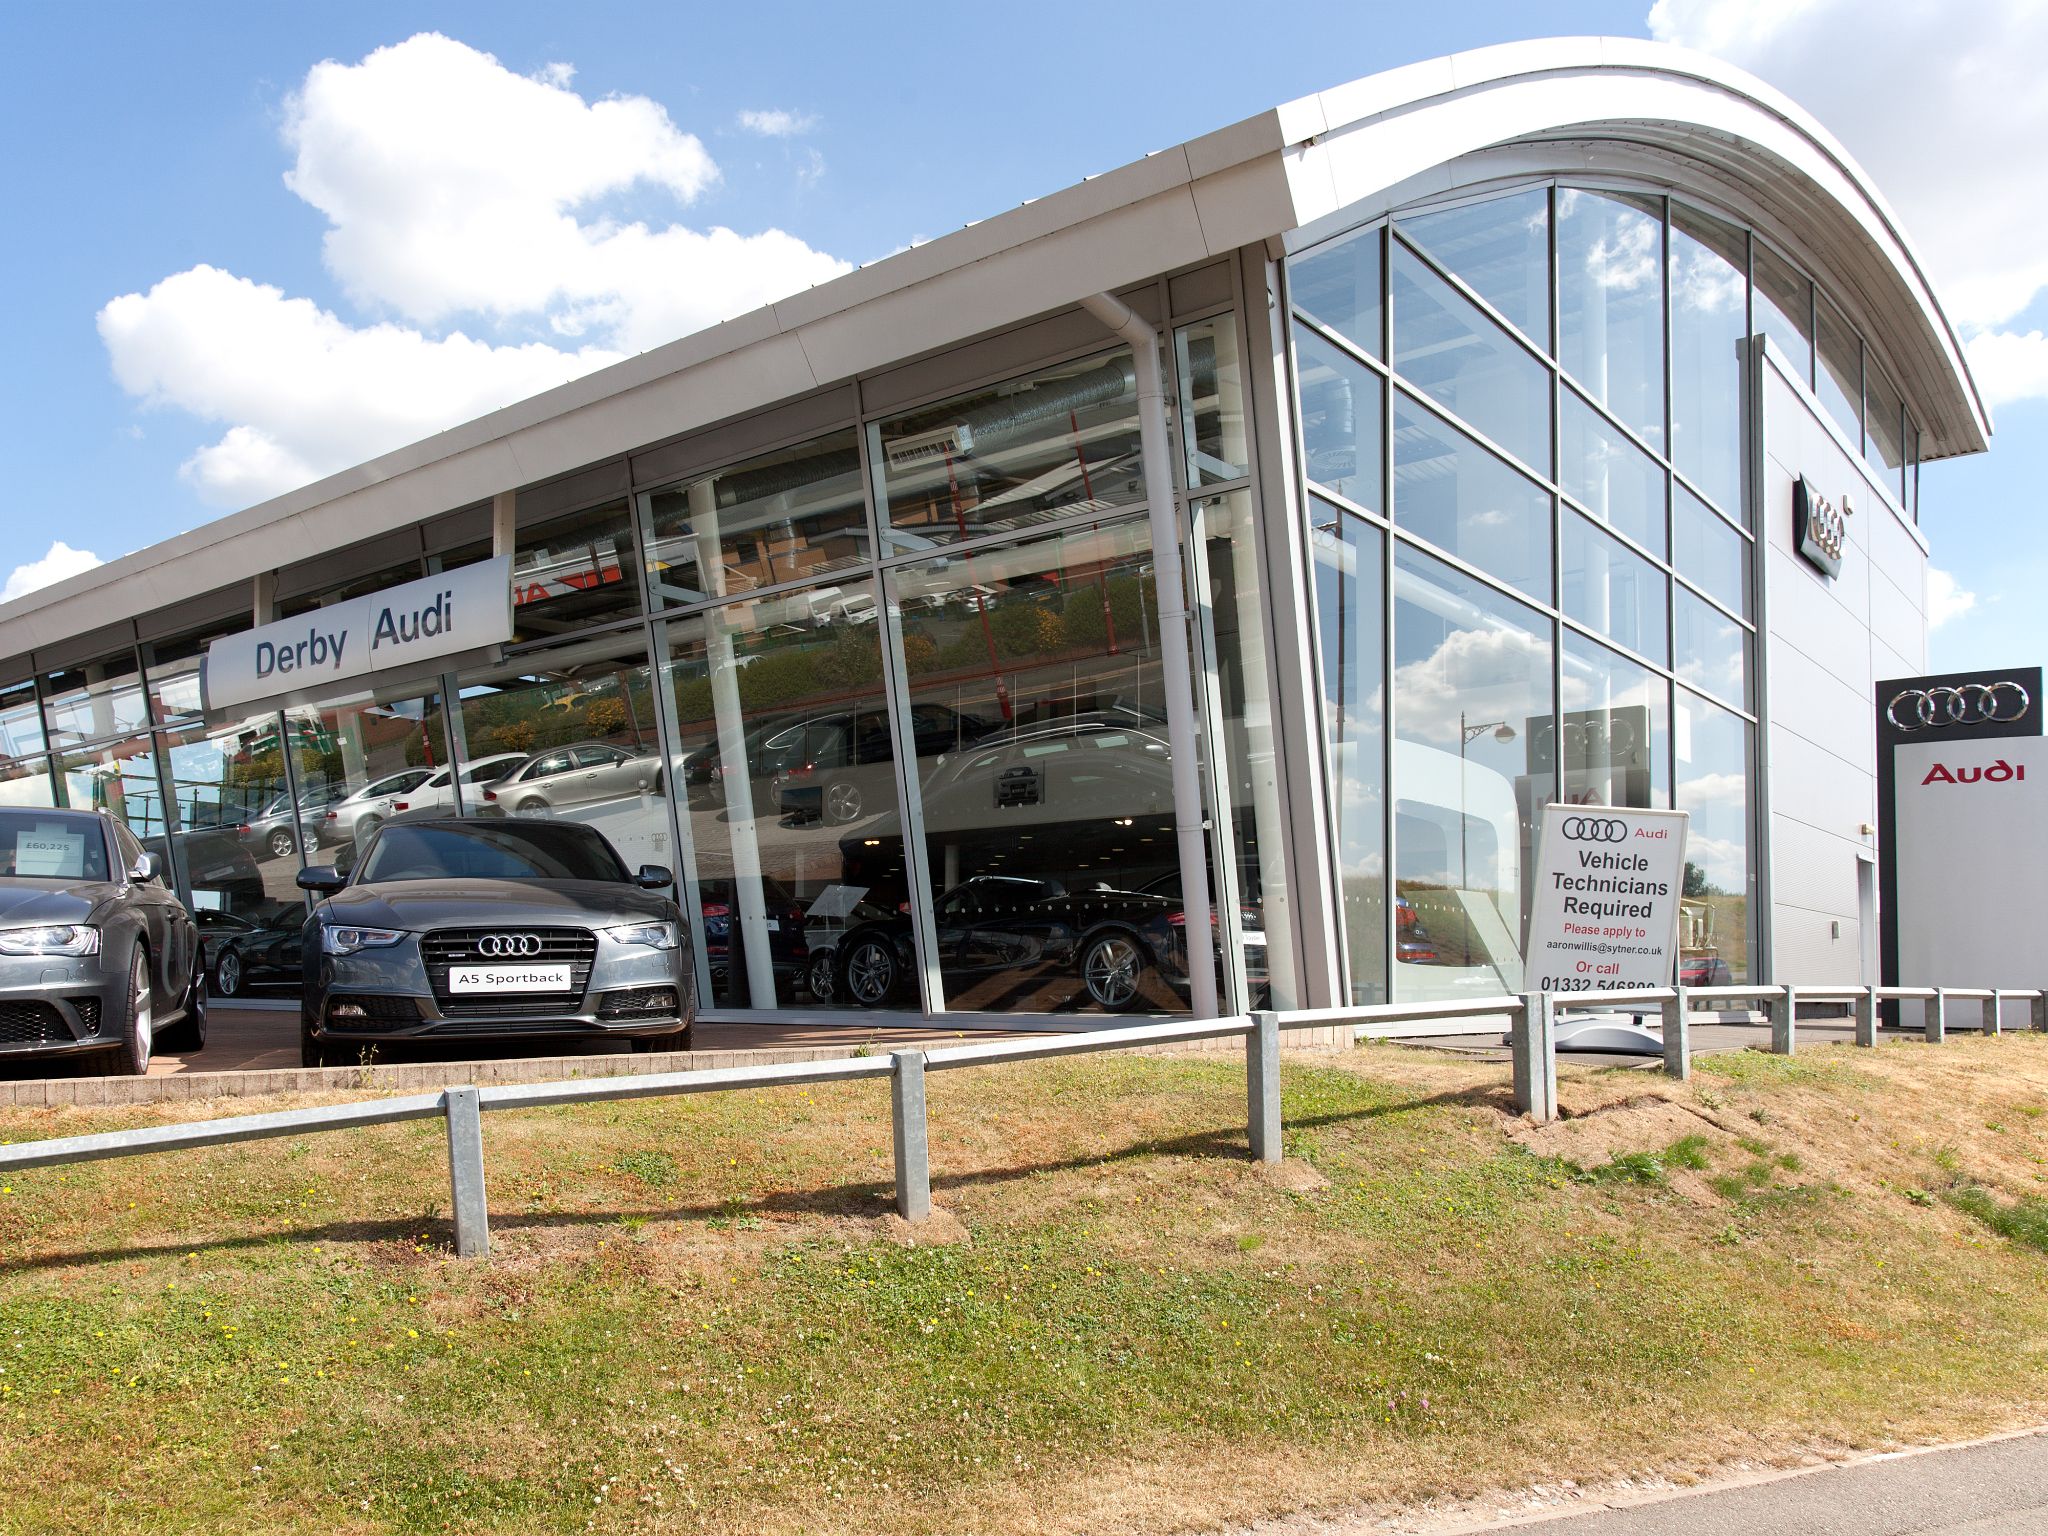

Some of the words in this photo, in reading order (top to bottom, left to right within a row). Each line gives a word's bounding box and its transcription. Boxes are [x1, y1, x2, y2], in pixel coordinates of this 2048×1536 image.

[256, 628, 348, 679] Derby
[372, 590, 452, 650] Audi
[1920, 759, 2025, 786] Audi
[1634, 828, 1668, 839] Audi
[1579, 850, 1649, 871] Vehicle
[1552, 872, 1668, 896] Technicians
[1563, 896, 1652, 919] Required
[1564, 923, 1600, 935] Please
[1603, 926, 1632, 939] apply
[1635, 928, 1646, 937] to
[1546, 941, 1662, 955] aaronwillis@sytner.co.uk
[1576, 961, 1592, 973] Or
[1596, 963, 1619, 974] call
[459, 974, 480, 984] A5
[485, 973, 563, 985] Sportback
[1541, 976, 1591, 992] 01332
